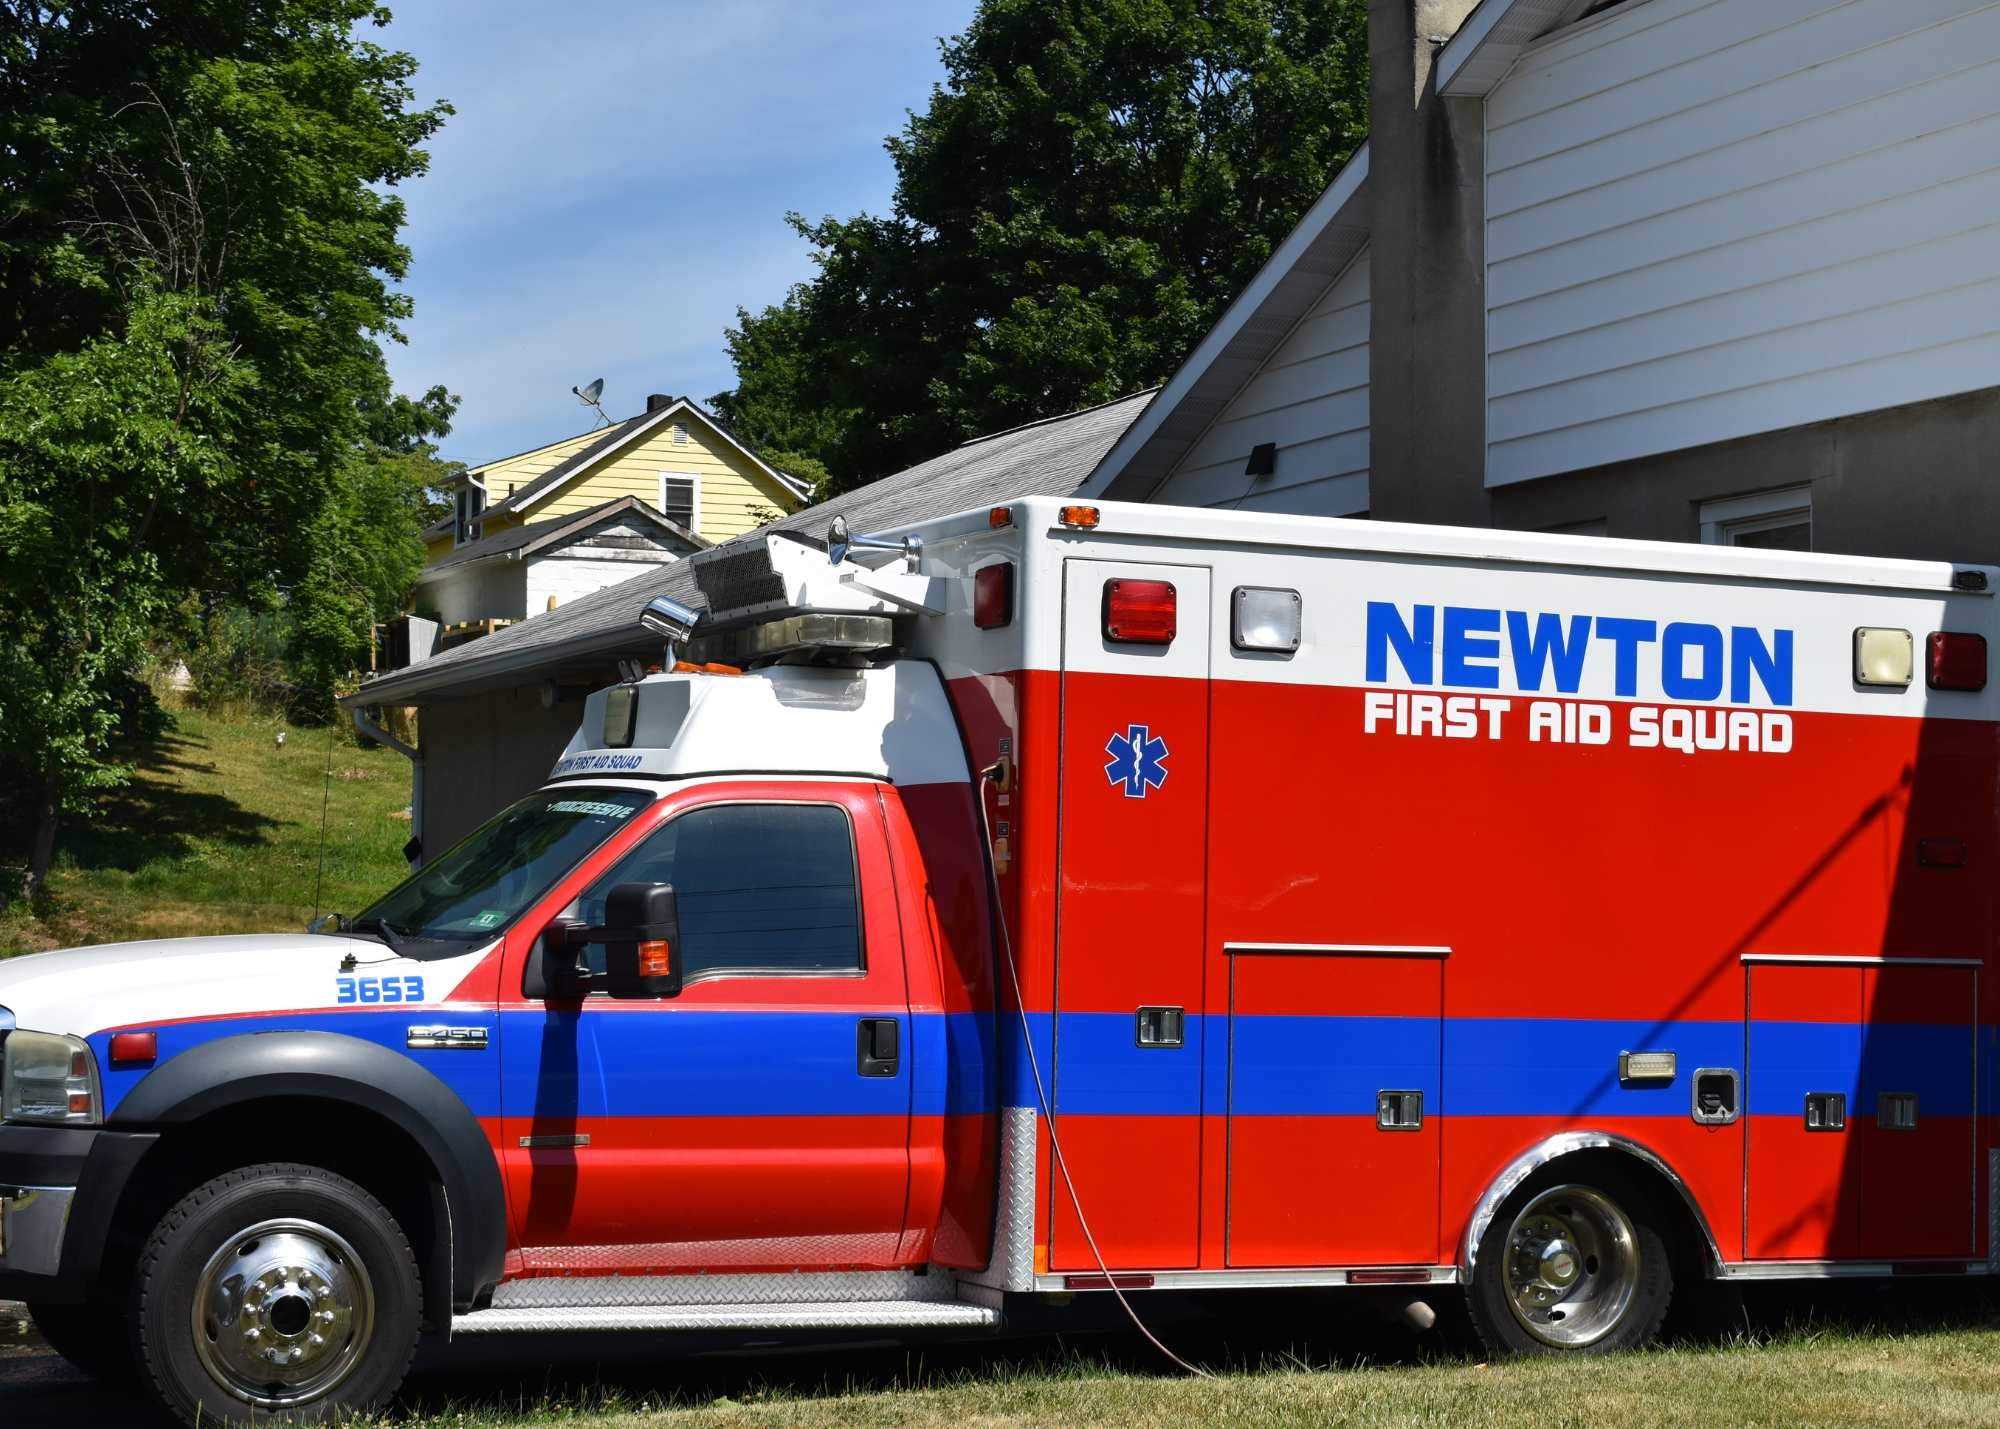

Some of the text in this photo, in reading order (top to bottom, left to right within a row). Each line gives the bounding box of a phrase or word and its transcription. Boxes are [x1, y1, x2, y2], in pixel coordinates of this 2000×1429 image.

[1366, 601, 1794, 706] NEWTON
[1364, 692, 1793, 754] FIRST AID SQUAD
[573, 756, 596, 770] FIRST
[592, 756, 609, 769] AID
[607, 755, 642, 769] SQUAD
[336, 976, 425, 1004] 3653
